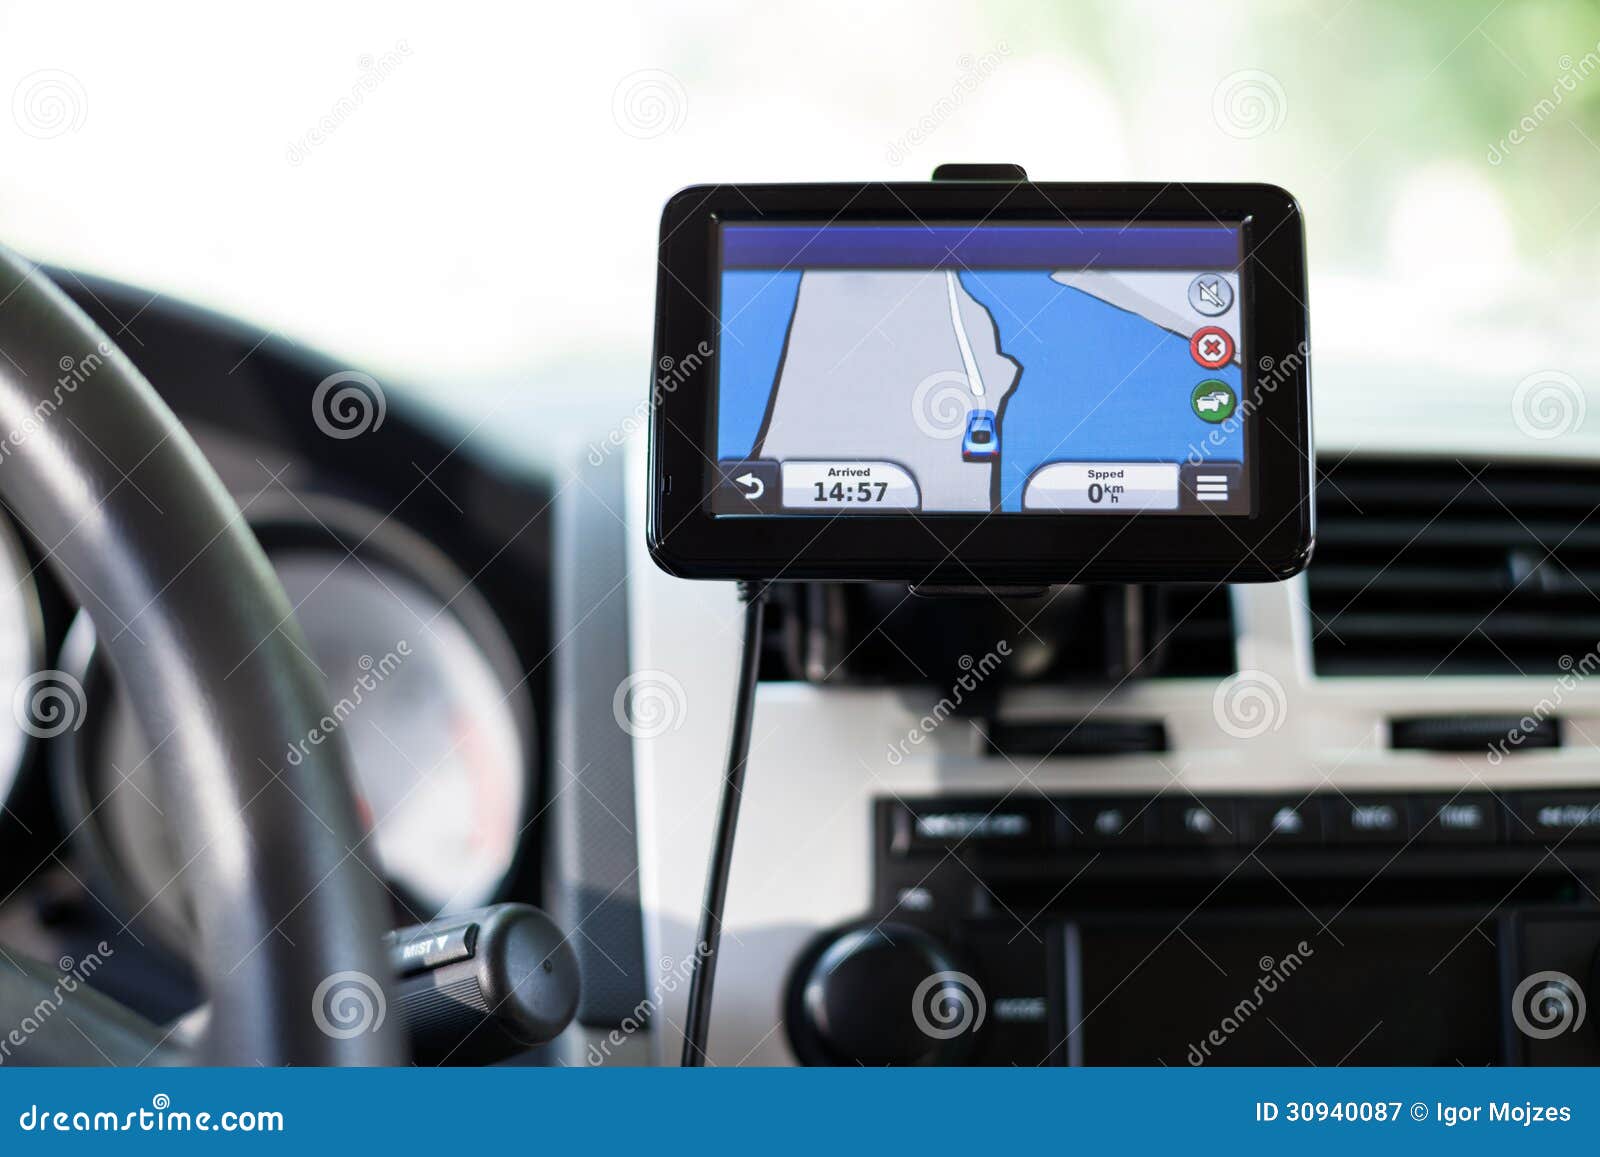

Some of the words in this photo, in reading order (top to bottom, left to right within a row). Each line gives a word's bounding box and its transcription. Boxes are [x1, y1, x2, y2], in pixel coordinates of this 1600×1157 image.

[827, 467, 871, 477] Arrived
[1087, 469, 1124, 479] Spped
[814, 481, 888, 502] 14:57
[403, 940, 434, 959] MIST
